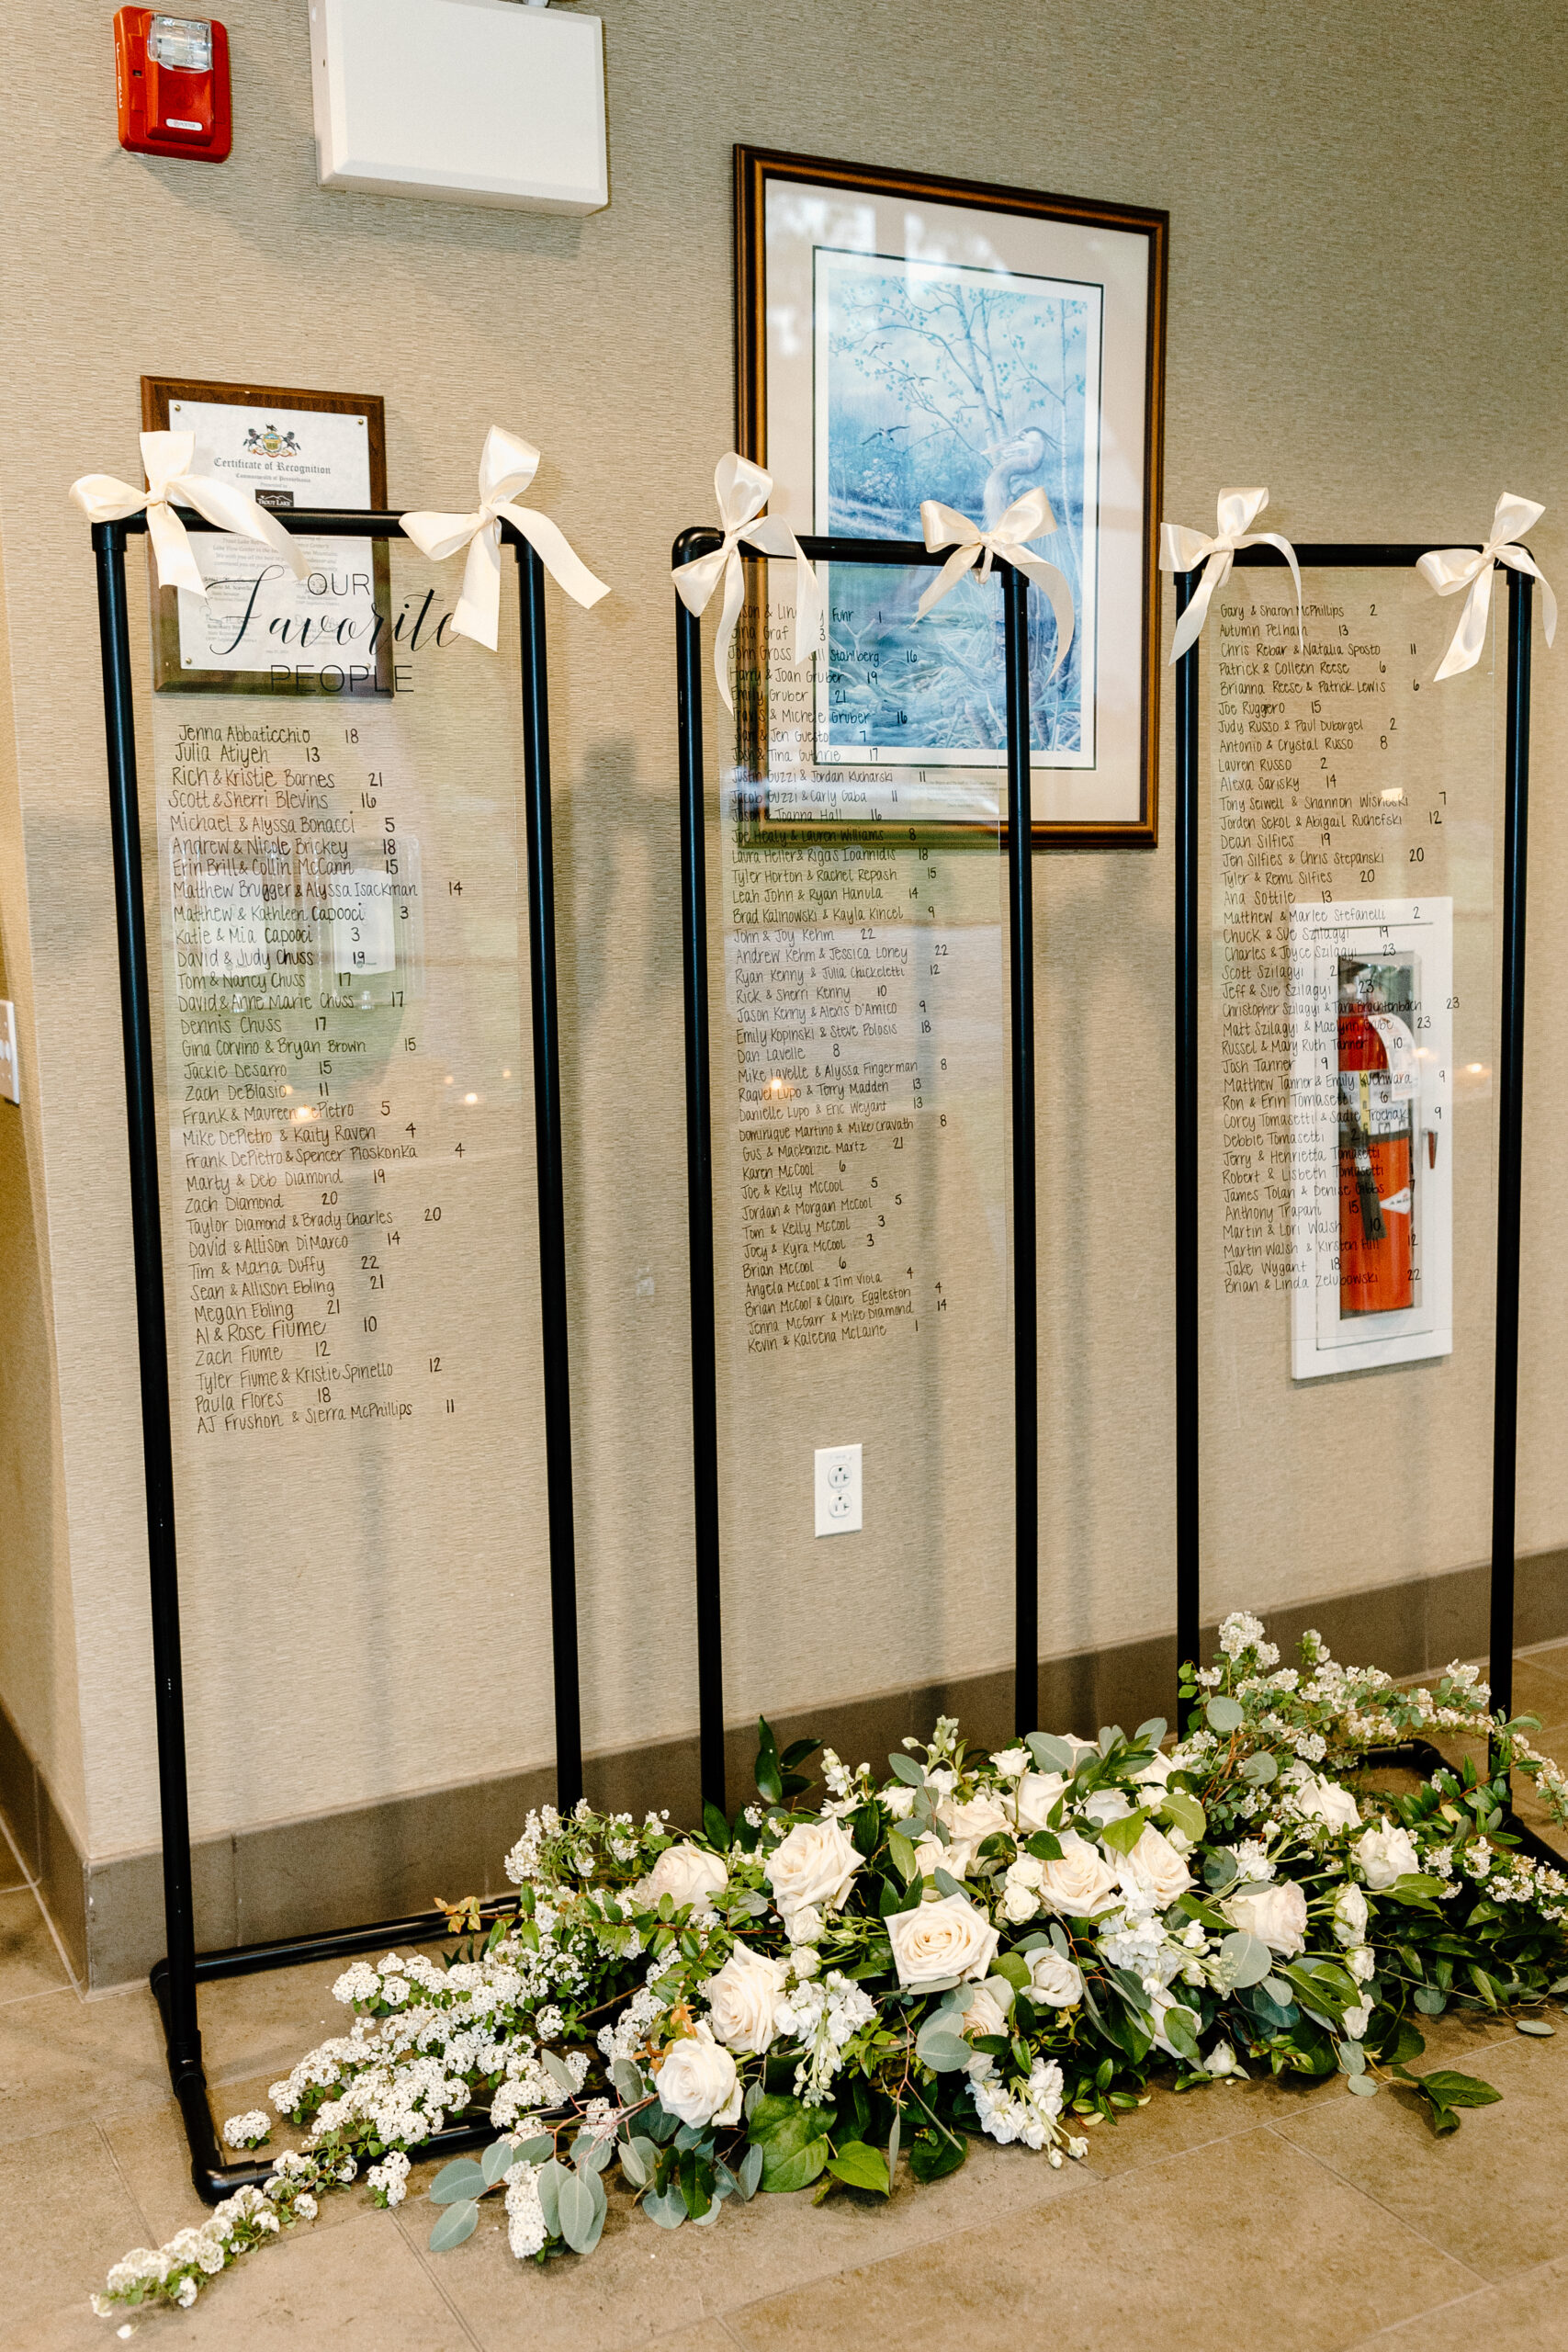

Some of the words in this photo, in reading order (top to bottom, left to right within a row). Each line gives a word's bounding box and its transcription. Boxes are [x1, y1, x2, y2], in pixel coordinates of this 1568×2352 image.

[214, 458, 261, 470] Certificate
[265, 462, 272, 470] of
[276, 462, 331, 474] Recognition
[307, 572, 369, 595] OUR
[271, 665, 414, 692] PEOPLE
[1220, 662, 1258, 675] Patrick
[1263, 662, 1269, 673] &
[1275, 662, 1314, 674] Colleen
[1320, 662, 1349, 673] Reese
[1380, 662, 1386, 673] 6
[179, 725, 223, 743] Jenna
[345, 729, 359, 743] 18
[175, 743, 209, 763] Julia
[220, 746, 270, 767] Atiyeh
[307, 747, 320, 763] 13
[1220, 739, 1261, 752] Antonio
[1267, 740, 1272, 750] &
[1278, 739, 1318, 756] Crystal
[1381, 736, 1388, 750] 8
[1218, 758, 1254, 772] Lauren
[1321, 758, 1328, 769] 2
[172, 766, 209, 786] Rich
[213, 774, 222, 786] &
[225, 767, 277, 787] Kristie
[284, 770, 335, 787] Barnes
[368, 772, 383, 787] 21
[1220, 776, 1253, 791] Alexa
[1326, 775, 1337, 788] 14
[168, 791, 209, 808] Scott
[213, 796, 221, 808] &
[224, 790, 269, 808] Sherri
[276, 789, 328, 808] Blevins
[361, 793, 377, 808] 16
[170, 812, 231, 832] Michael
[240, 818, 248, 831] &
[253, 817, 296, 835] Alyssa
[386, 818, 395, 832] 5
[1221, 834, 1250, 849] Dean
[1321, 833, 1330, 845] 19
[731, 870, 761, 887] Tyler
[765, 868, 802, 883] Horton
[807, 871, 813, 880] &
[818, 870, 853, 883] Rachel
[928, 867, 936, 878] 15
[1221, 873, 1249, 888] Tyler
[1255, 874, 1260, 883] &
[1359, 869, 1374, 883] 20
[733, 889, 759, 903] Leah
[764, 888, 793, 902] John
[798, 889, 805, 899] &
[809, 888, 838, 906] Ryan
[908, 887, 919, 899] 14
[1224, 891, 1245, 906] Ana
[1322, 890, 1332, 903] 13
[737, 949, 779, 963] Andrew
[819, 948, 825, 958] &
[829, 946, 869, 960] Jessica
[935, 944, 948, 956] 22
[176, 973, 205, 988] Tom
[209, 975, 219, 986] &
[223, 972, 266, 992] Nancy
[271, 973, 306, 988] Chuss
[339, 972, 351, 986] 17
[737, 989, 761, 1003] Rick
[766, 989, 773, 1001] &
[776, 987, 808, 1001] Sherri
[817, 986, 850, 1002] Kenny
[877, 986, 886, 996] 10
[737, 1007, 769, 1023] Jason
[774, 1006, 806, 1024] Kenny
[810, 1007, 817, 1016] &
[855, 1001, 897, 1015] D'Amico
[919, 1001, 926, 1012] 9
[181, 1014, 231, 1035] Dennis
[241, 1017, 282, 1033] Chuss
[315, 1017, 326, 1031] 17
[182, 1040, 210, 1057] Gina
[265, 1041, 274, 1053] &
[277, 1038, 321, 1059] Bryan
[328, 1039, 366, 1053] Brown
[405, 1037, 416, 1051] 15
[737, 1049, 759, 1063] Dan
[766, 1046, 806, 1061] Lavelle
[833, 1044, 840, 1057] 8
[184, 1062, 227, 1079] Jackie
[320, 1060, 333, 1075] 15
[1222, 1059, 1248, 1074] Josh
[1254, 1058, 1295, 1072] Tanner
[1321, 1057, 1328, 1069] 9
[186, 1083, 219, 1101] Zach
[320, 1082, 329, 1097] 11
[742, 1167, 773, 1180] Karen
[840, 1159, 846, 1172] 6
[185, 1196, 218, 1213] Zach
[226, 1194, 284, 1211] Diamond
[321, 1192, 337, 1205] 20
[189, 1237, 226, 1258] David
[234, 1242, 243, 1253] &
[388, 1231, 400, 1246] 14
[742, 1262, 773, 1278] Brian
[839, 1257, 846, 1269] 6
[1225, 1261, 1253, 1277] Jake
[1260, 1260, 1307, 1277] Wygant
[1331, 1257, 1340, 1270] 18
[745, 1300, 775, 1317] Brian
[817, 1298, 821, 1306] &
[826, 1294, 854, 1306] Claire
[862, 1288, 911, 1305] Eggleston
[935, 1282, 942, 1294] 4
[195, 1306, 246, 1323] Megan
[252, 1301, 294, 1319] Ebling
[327, 1299, 340, 1314] 21
[195, 1351, 231, 1366] Zach
[242, 1345, 283, 1363] Fiume
[316, 1340, 331, 1356] 12
[195, 1395, 234, 1413] Paula
[242, 1392, 283, 1408] Flores
[318, 1387, 331, 1403] 18
[197, 1415, 216, 1433] AJ
[292, 1411, 300, 1422] &
[305, 1406, 344, 1423] Sierra
[446, 1399, 454, 1413] 11
